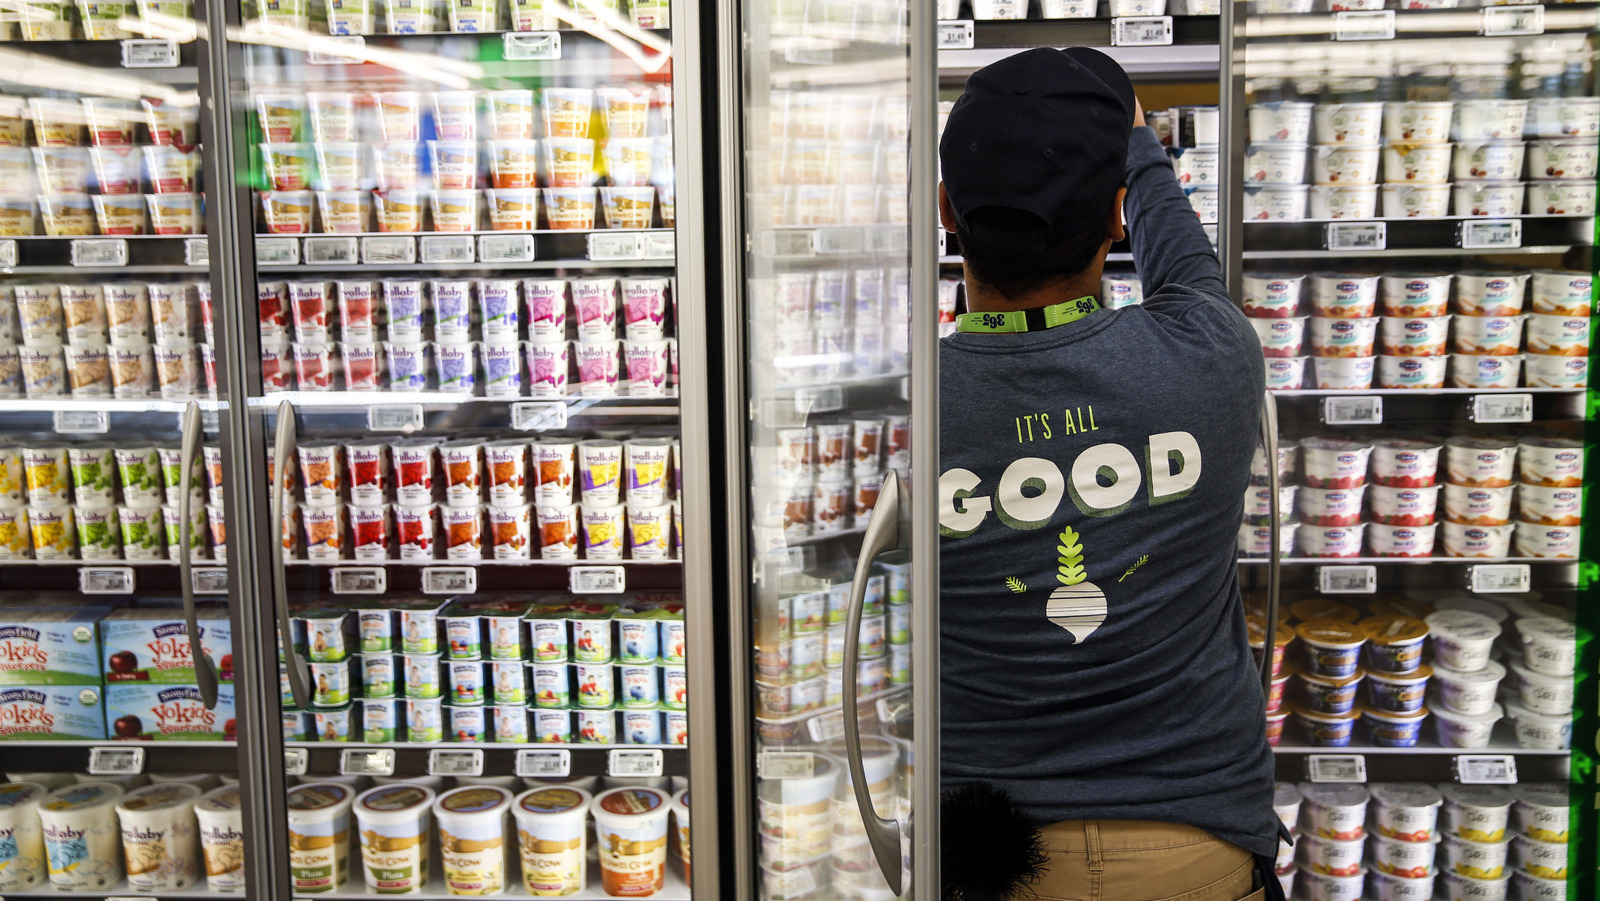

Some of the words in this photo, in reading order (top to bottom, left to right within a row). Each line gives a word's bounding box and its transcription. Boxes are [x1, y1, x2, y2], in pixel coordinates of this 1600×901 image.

[624, 285, 659, 296] wallaby
[1075, 298, 1095, 314] 365
[982, 313, 1005, 329] 365
[1015, 412, 1053, 443] IT'S
[1065, 405, 1099, 436] ALL
[939, 431, 1202, 538] GOOD
[0, 641, 48, 664] okids
[0, 662, 47, 672] queezers
[0, 704, 54, 729] okids
[301, 869, 324, 878] Plain
[382, 870, 404, 879] Plain
